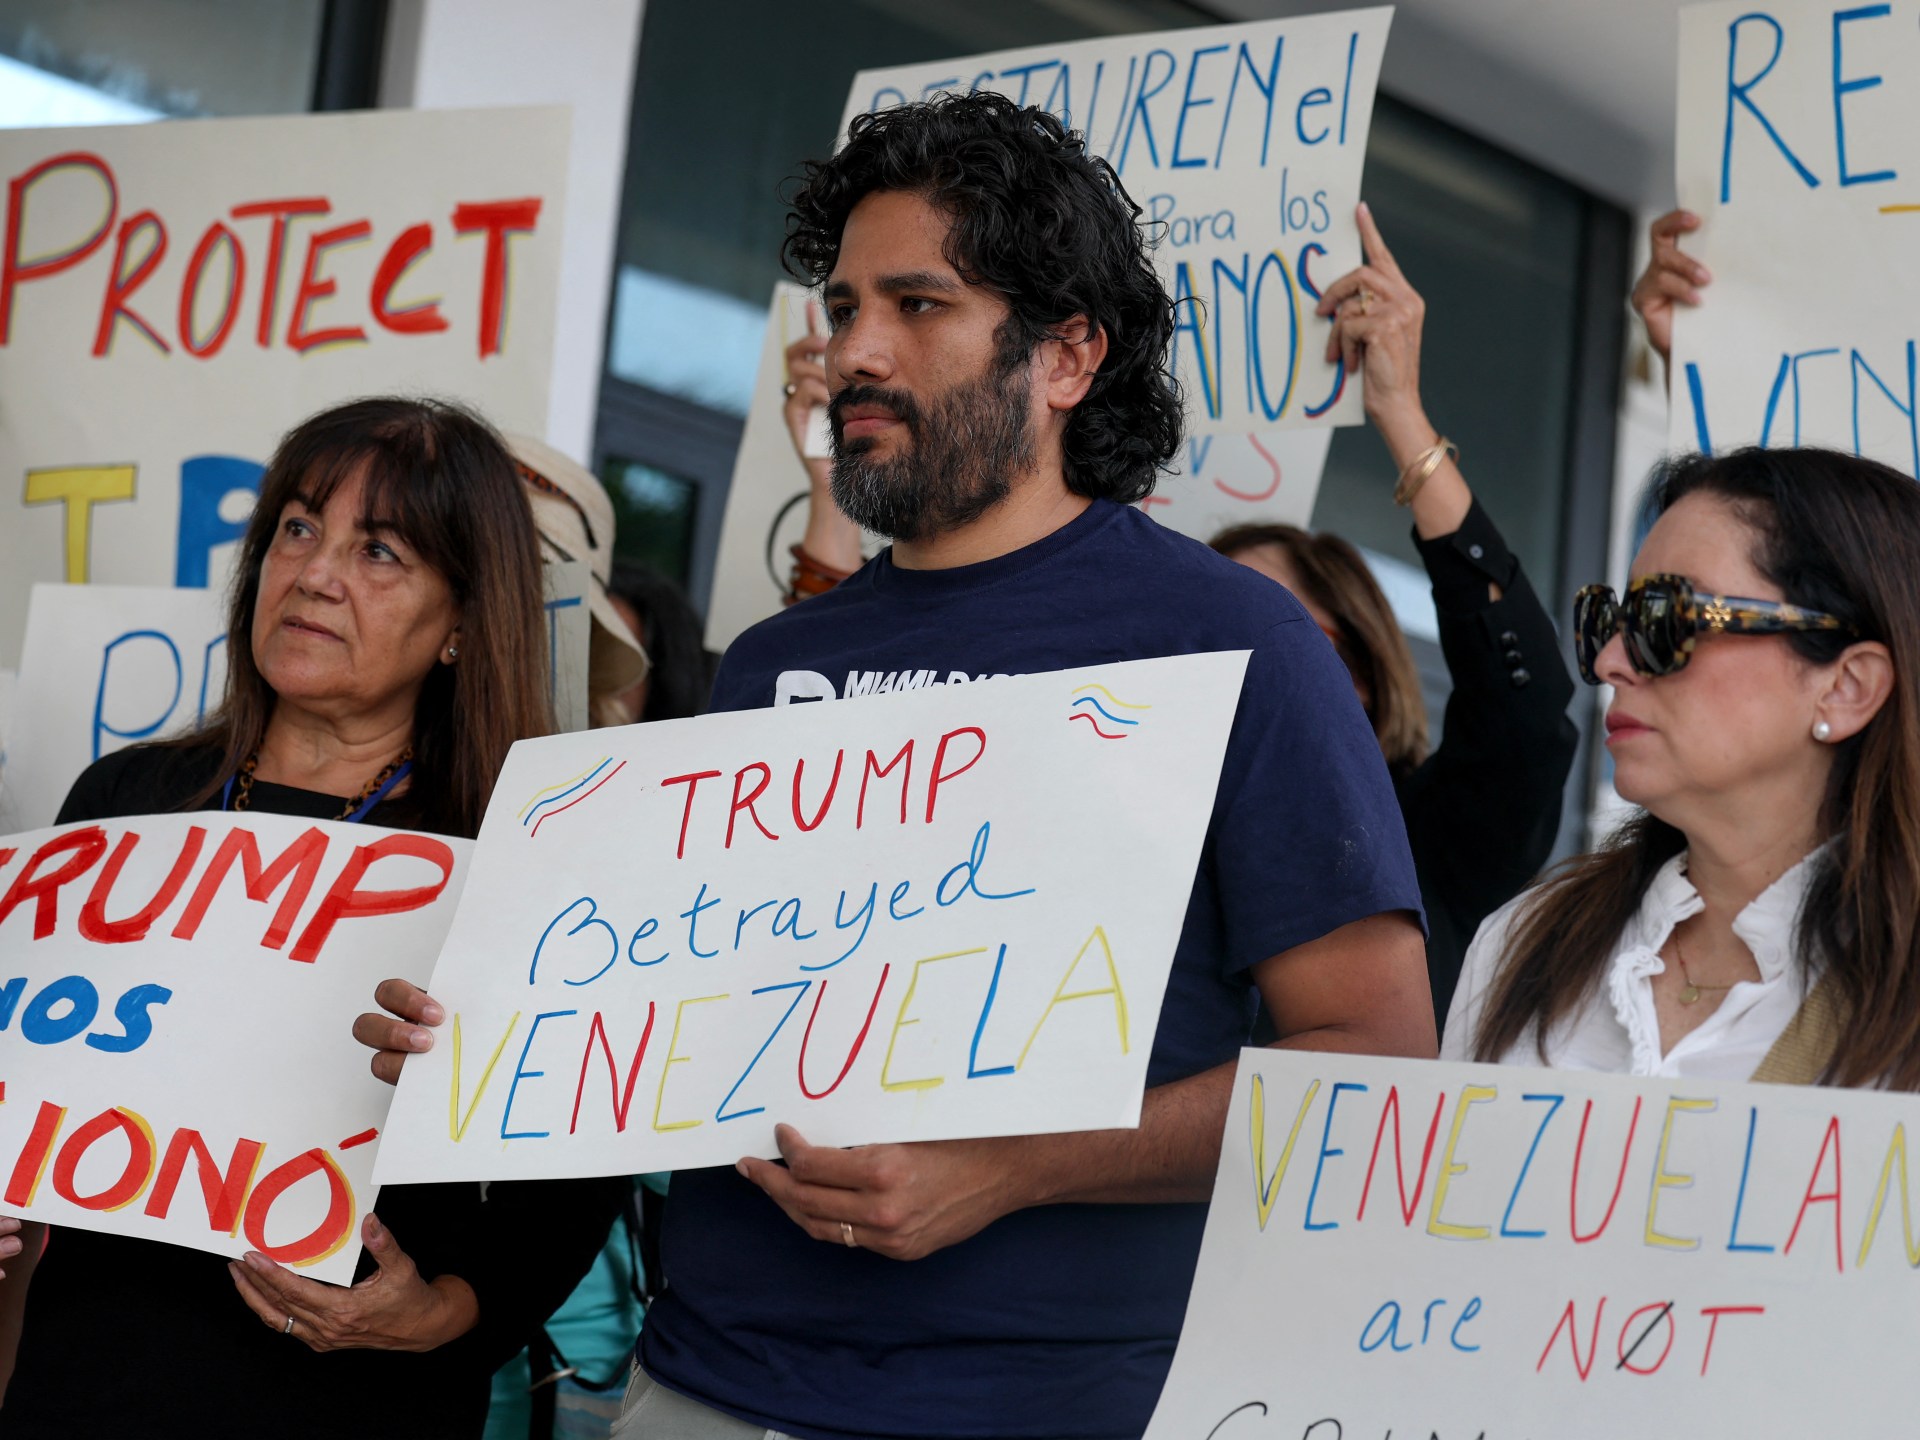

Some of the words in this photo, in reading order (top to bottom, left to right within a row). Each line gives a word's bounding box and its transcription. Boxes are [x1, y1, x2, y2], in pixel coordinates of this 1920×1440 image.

[868, 33, 1284, 176] TAUREN
[1295, 32, 1359, 146] el
[1720, 4, 1920, 204] RE
[0, 151, 543, 361] PROTECT
[1148, 192, 1236, 251] Para
[1280, 168, 1332, 236] los
[1167, 243, 1348, 422] ANOS
[23, 453, 267, 589] TP
[661, 727, 986, 859] TRUMP
[0, 825, 454, 963] RUMP
[530, 822, 1036, 986] Betrayed
[448, 926, 1129, 1146] VENEZUELA
[0, 1081, 380, 1267] IONÓ
[1359, 1296, 1482, 1352] are
